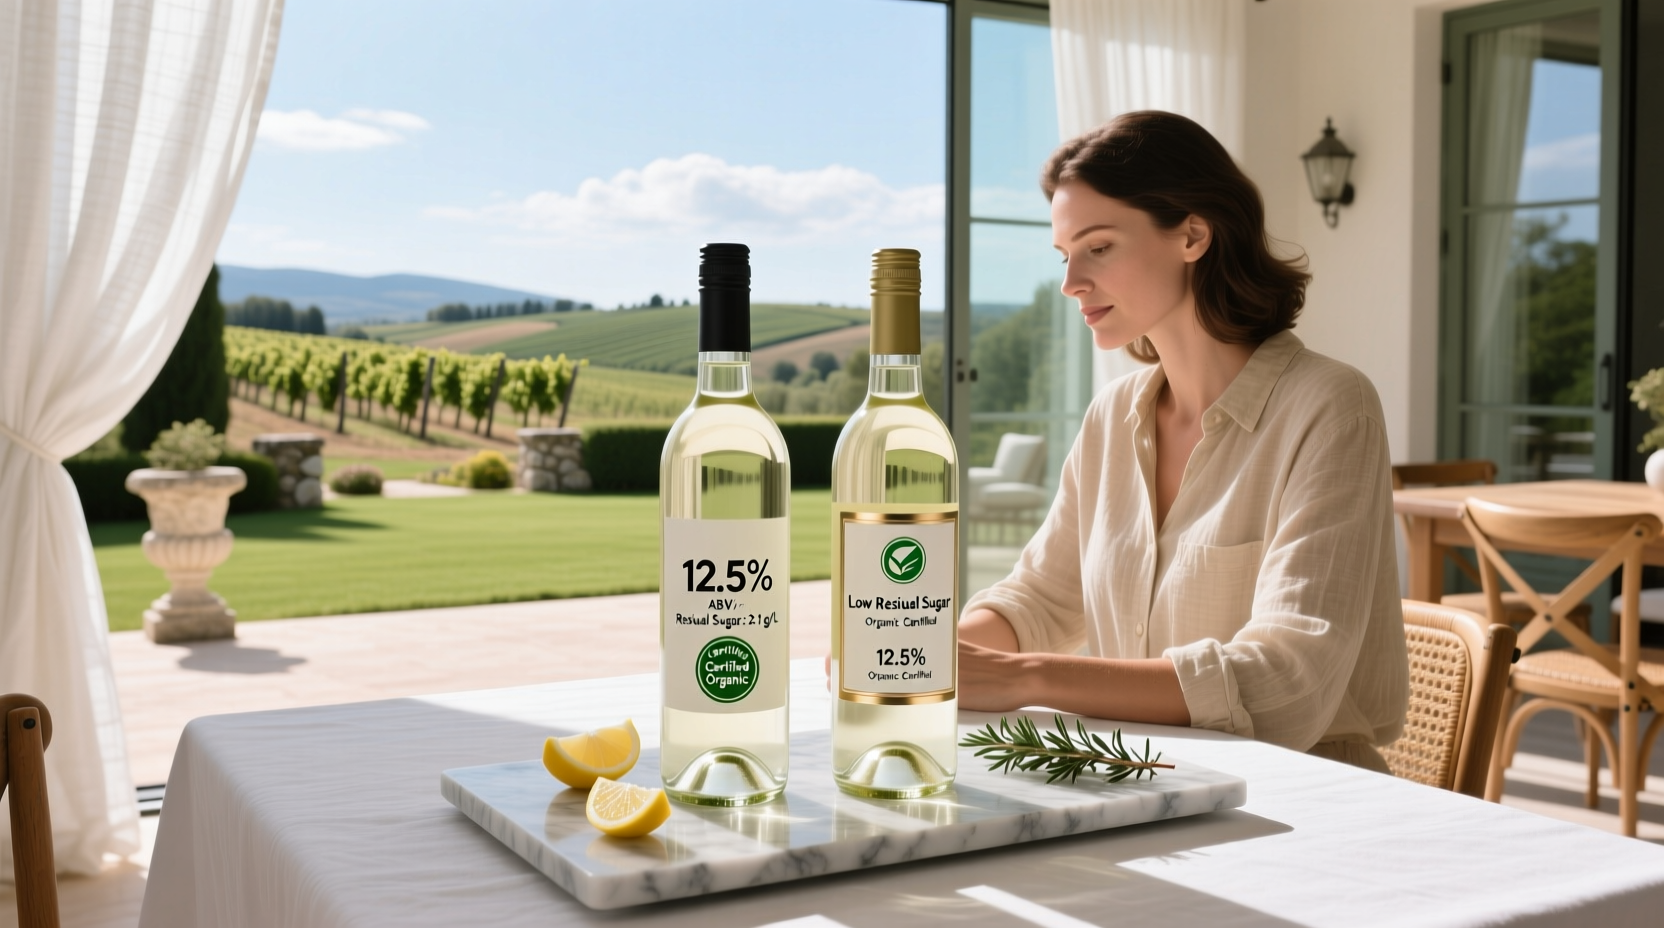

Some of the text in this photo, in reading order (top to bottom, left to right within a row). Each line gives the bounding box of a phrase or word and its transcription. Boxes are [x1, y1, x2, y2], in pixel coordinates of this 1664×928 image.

[682, 558, 773, 593] 12.5%
[848, 594, 872, 609] Low
[922, 595, 951, 612] Sugar
[876, 647, 926, 666] 12.5%
[705, 672, 749, 689] Organic
